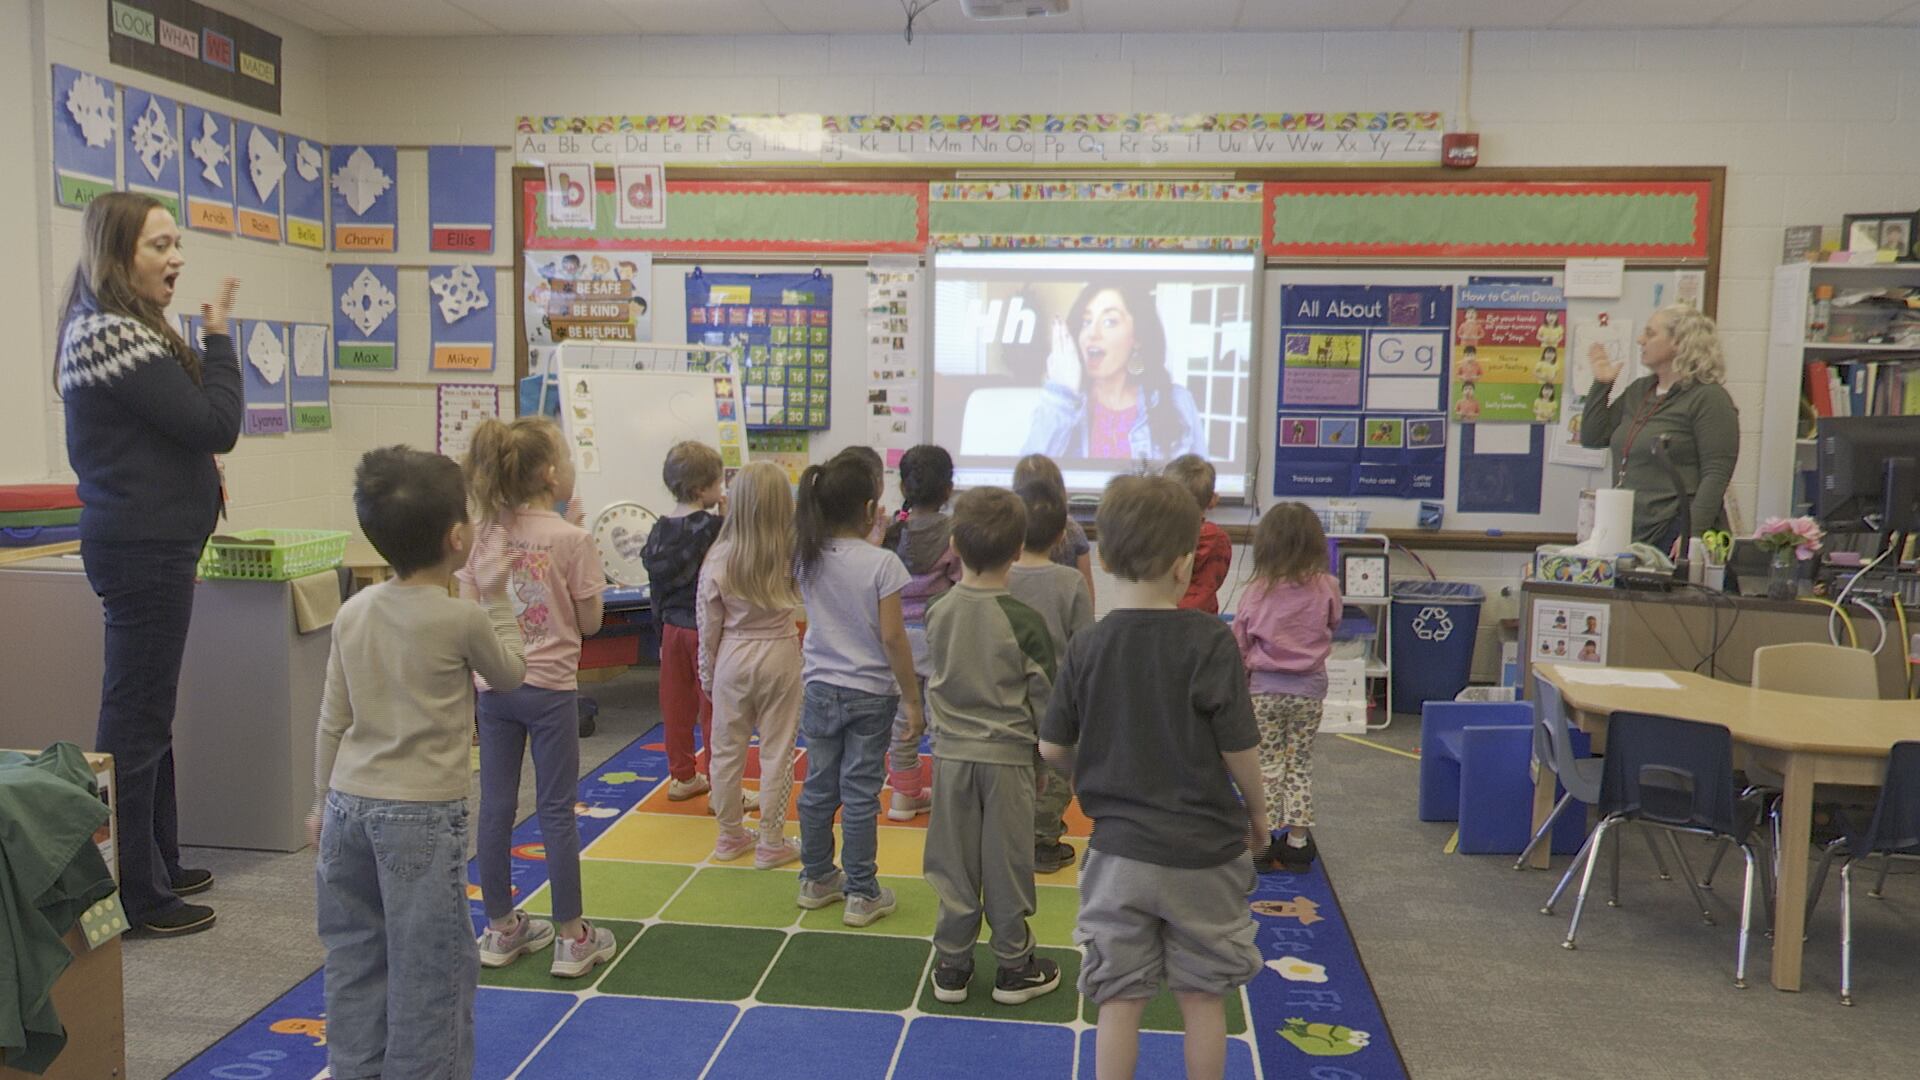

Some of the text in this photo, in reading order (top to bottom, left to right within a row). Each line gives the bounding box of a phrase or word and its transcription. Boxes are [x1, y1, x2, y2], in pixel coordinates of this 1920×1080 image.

[115, 9, 153, 38] LOOK
[162, 25, 196, 50] WHAT
[207, 35, 231, 64] WE
[522, 138, 546, 153] Aa
[558, 138, 580, 153] Bb
[591, 139, 612, 153] Cc
[626, 135, 648, 153] Dd
[664, 136, 682, 152] Ee
[696, 135, 712, 152] Ff
[727, 134, 751, 159] Gg
[825, 134, 843, 160] Jj
[860, 134, 879, 152] Kk
[898, 134, 914, 152] Ll
[929, 134, 961, 152] Mm
[972, 134, 997, 152] Nn
[1006, 134, 1032, 152] Oo
[1044, 134, 1064, 160] Pp
[1078, 134, 1107, 160] Qq
[1120, 134, 1139, 152] Rr
[1151, 134, 1169, 152] Ss
[1218, 134, 1241, 152] Uu
[1253, 134, 1275, 152] Vv
[1287, 134, 1324, 152] Ww
[1335, 134, 1357, 152] Xx
[1368, 134, 1390, 160] Yy
[1403, 134, 1428, 152] Zz
[559, 173, 585, 208] b
[627, 174, 653, 209] d
[344, 231, 384, 246] Charvi
[446, 231, 475, 246] Ellis
[576, 282, 622, 294] BE SAFE
[1462, 290, 1562, 303] How to Calm Down
[573, 305, 619, 316] BE KIND
[1297, 300, 1320, 318] All
[1326, 300, 1382, 318] About
[568, 326, 632, 339] BE HELPFUL
[777, 330, 822, 342] 1 2 3
[353, 352, 379, 364] Max
[447, 353, 479, 366] Mikey
[795, 352, 802, 362] 9
[814, 353, 825, 363] 10
[751, 370, 825, 382] 14 15 16 17
[790, 392, 803, 402] 23
[252, 412, 283, 429] Lyanna
[789, 412, 823, 422] 30 31
[1359, 476, 1377, 484] Photo
[1270, 927, 1314, 952] Ee
